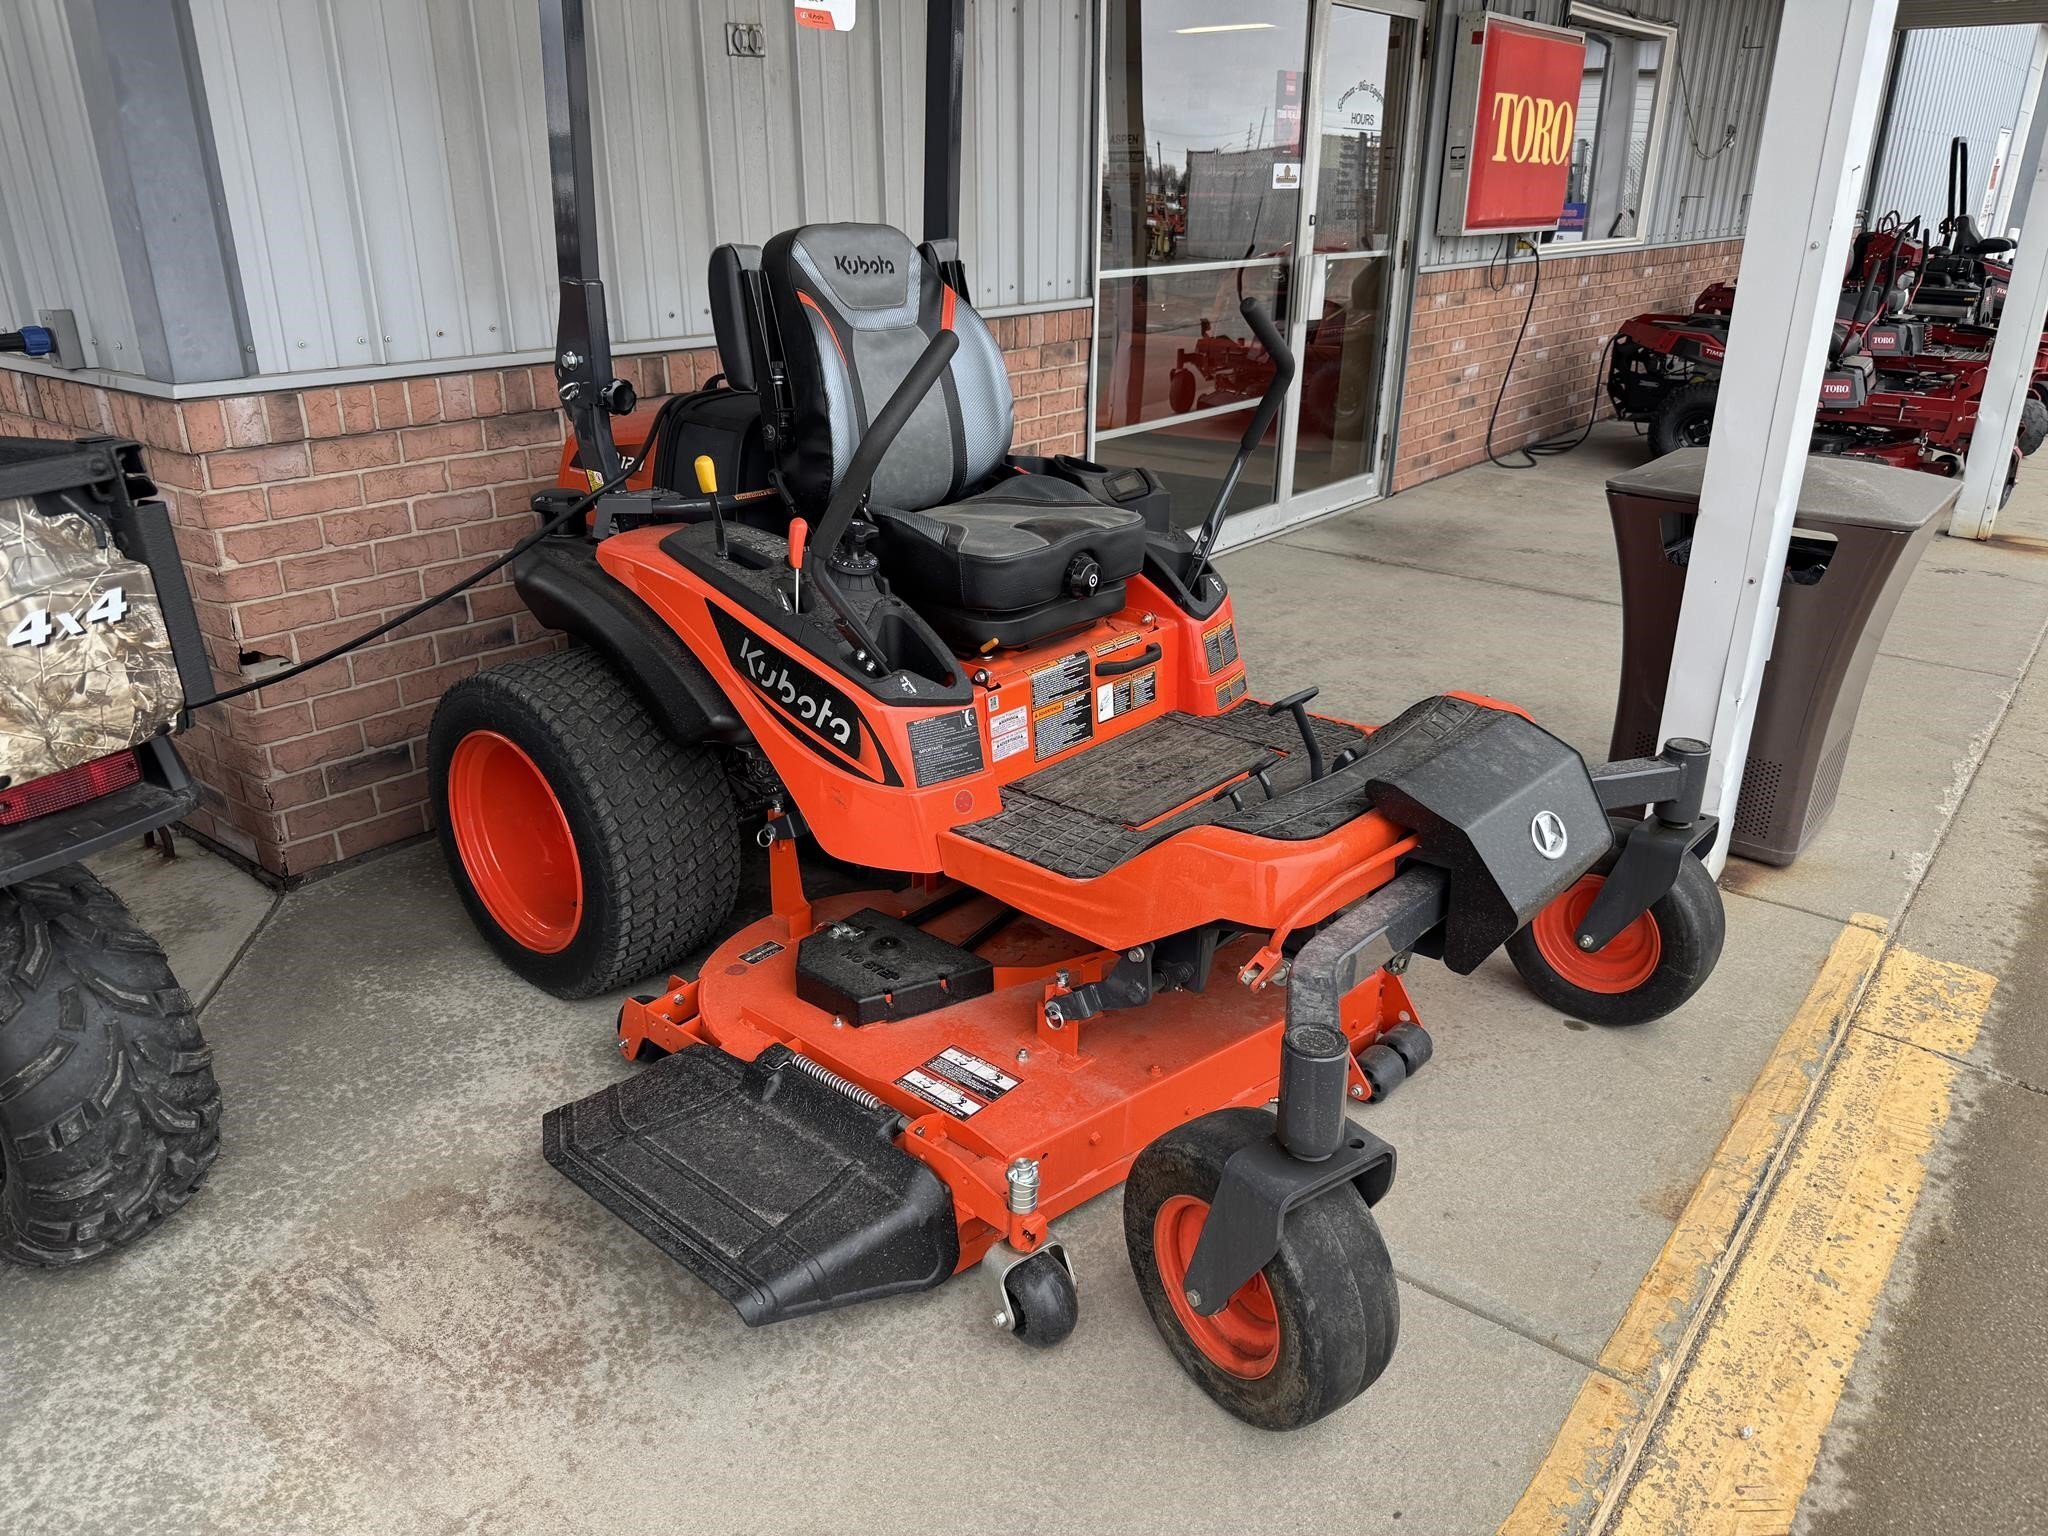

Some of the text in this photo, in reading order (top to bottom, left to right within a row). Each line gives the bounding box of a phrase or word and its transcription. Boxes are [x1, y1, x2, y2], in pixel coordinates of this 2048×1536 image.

[1351, 112, 1375, 126] HOURS
[1491, 92, 1574, 167] TORO
[1110, 134, 1140, 145] ASPEN
[833, 255, 895, 275] Kubota
[1873, 336, 1895, 344] TORO
[1824, 384, 1849, 393] TORO
[7, 587, 129, 648] 4x4
[740, 637, 851, 745] Kubota
